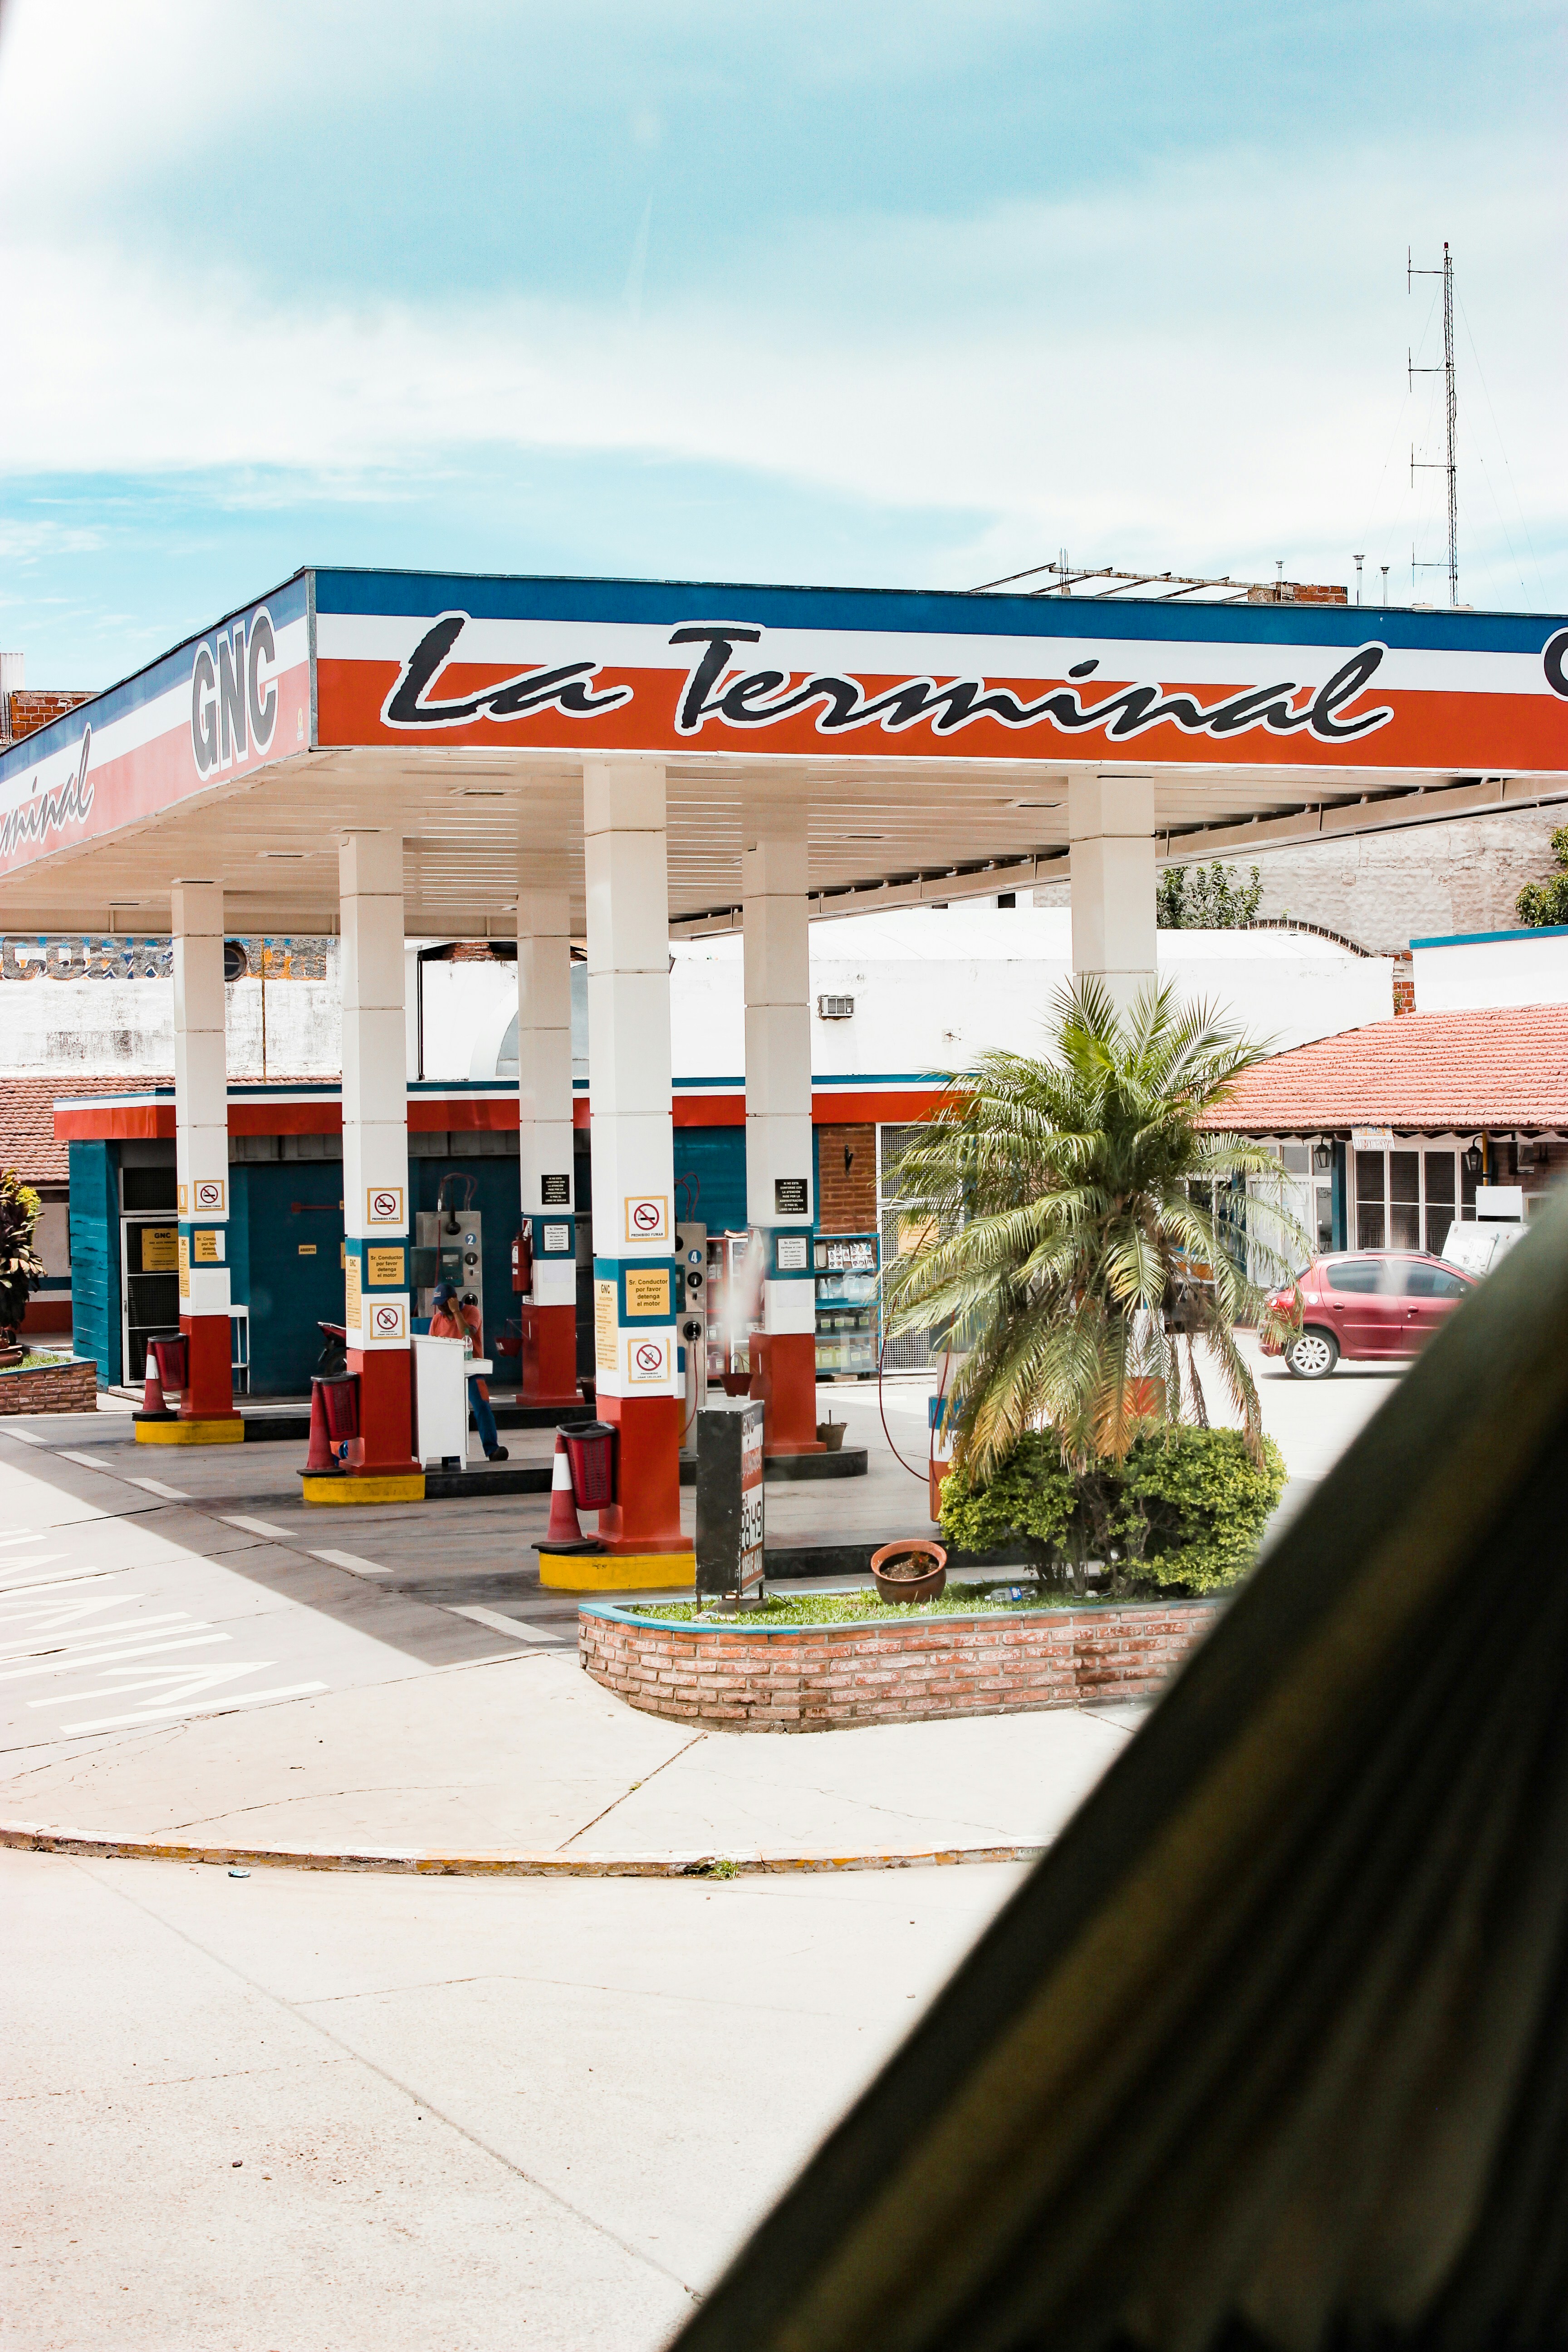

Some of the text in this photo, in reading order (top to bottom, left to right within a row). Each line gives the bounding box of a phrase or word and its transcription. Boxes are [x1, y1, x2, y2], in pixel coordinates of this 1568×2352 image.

[386, 615, 1390, 737] La Terminal
[191, 611, 277, 777] GNC
[467, 1235, 474, 1245] 2
[691, 1251, 697, 1263] 4
[601, 1284, 610, 1294] GNC
[743, 1411, 755, 1436] GNC
